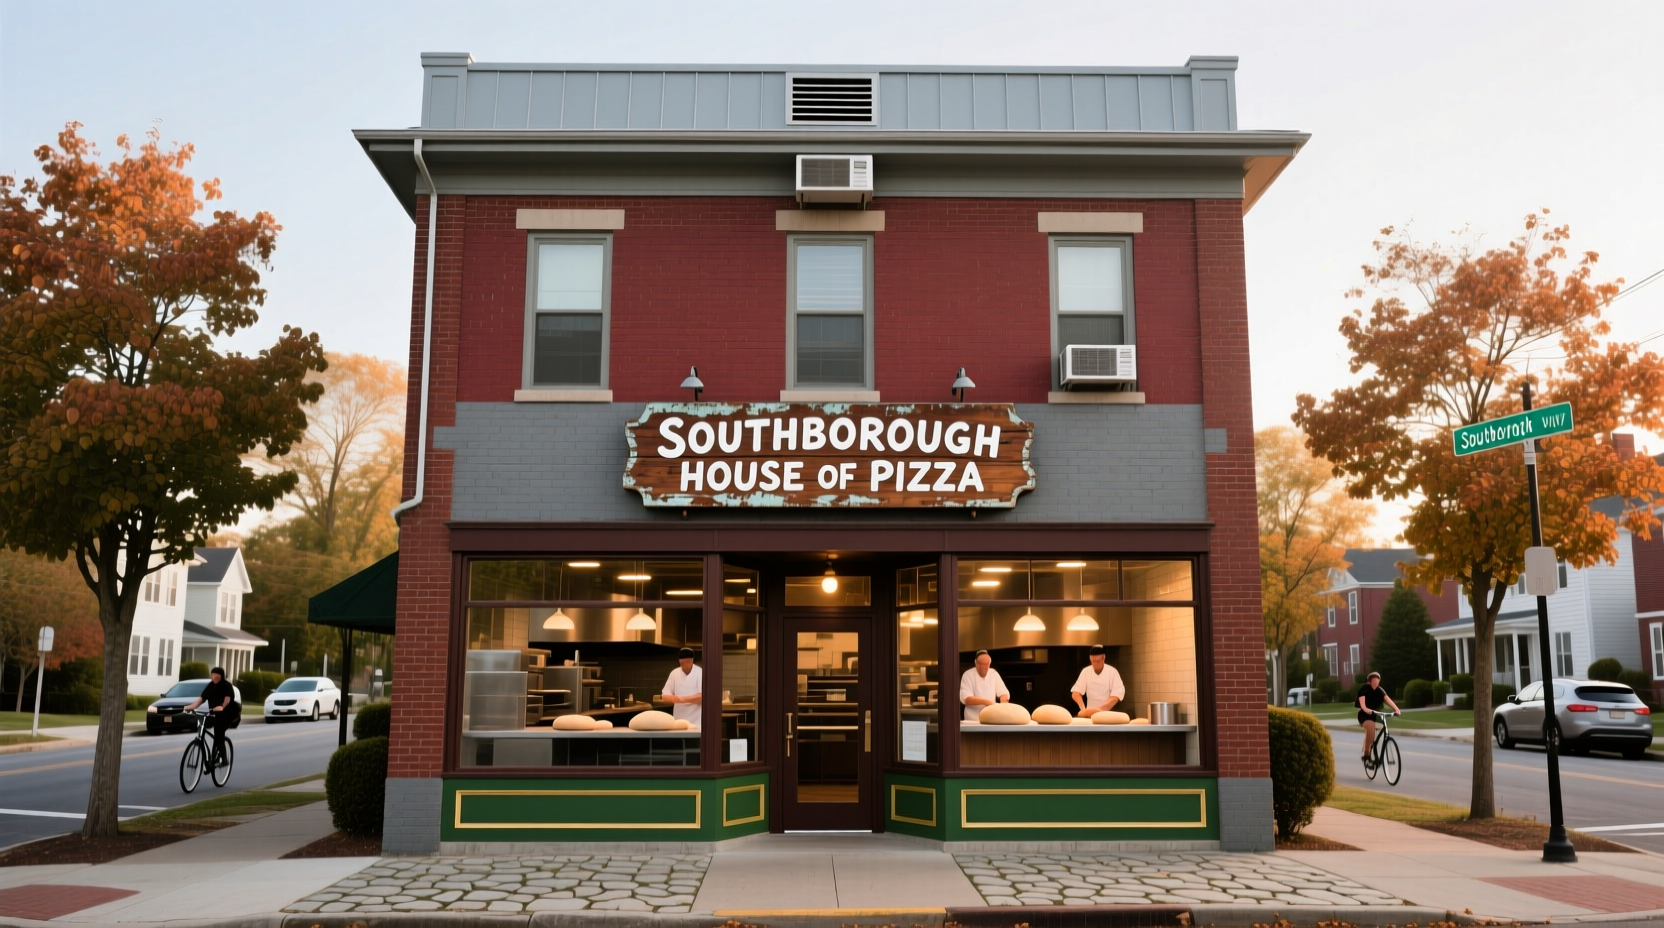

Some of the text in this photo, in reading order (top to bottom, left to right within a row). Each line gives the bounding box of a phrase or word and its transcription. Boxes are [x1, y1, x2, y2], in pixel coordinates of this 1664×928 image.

[657, 416, 1001, 458] SOUTHBOROUGH
[680, 459, 984, 492] HOUSE OF PIZZA
